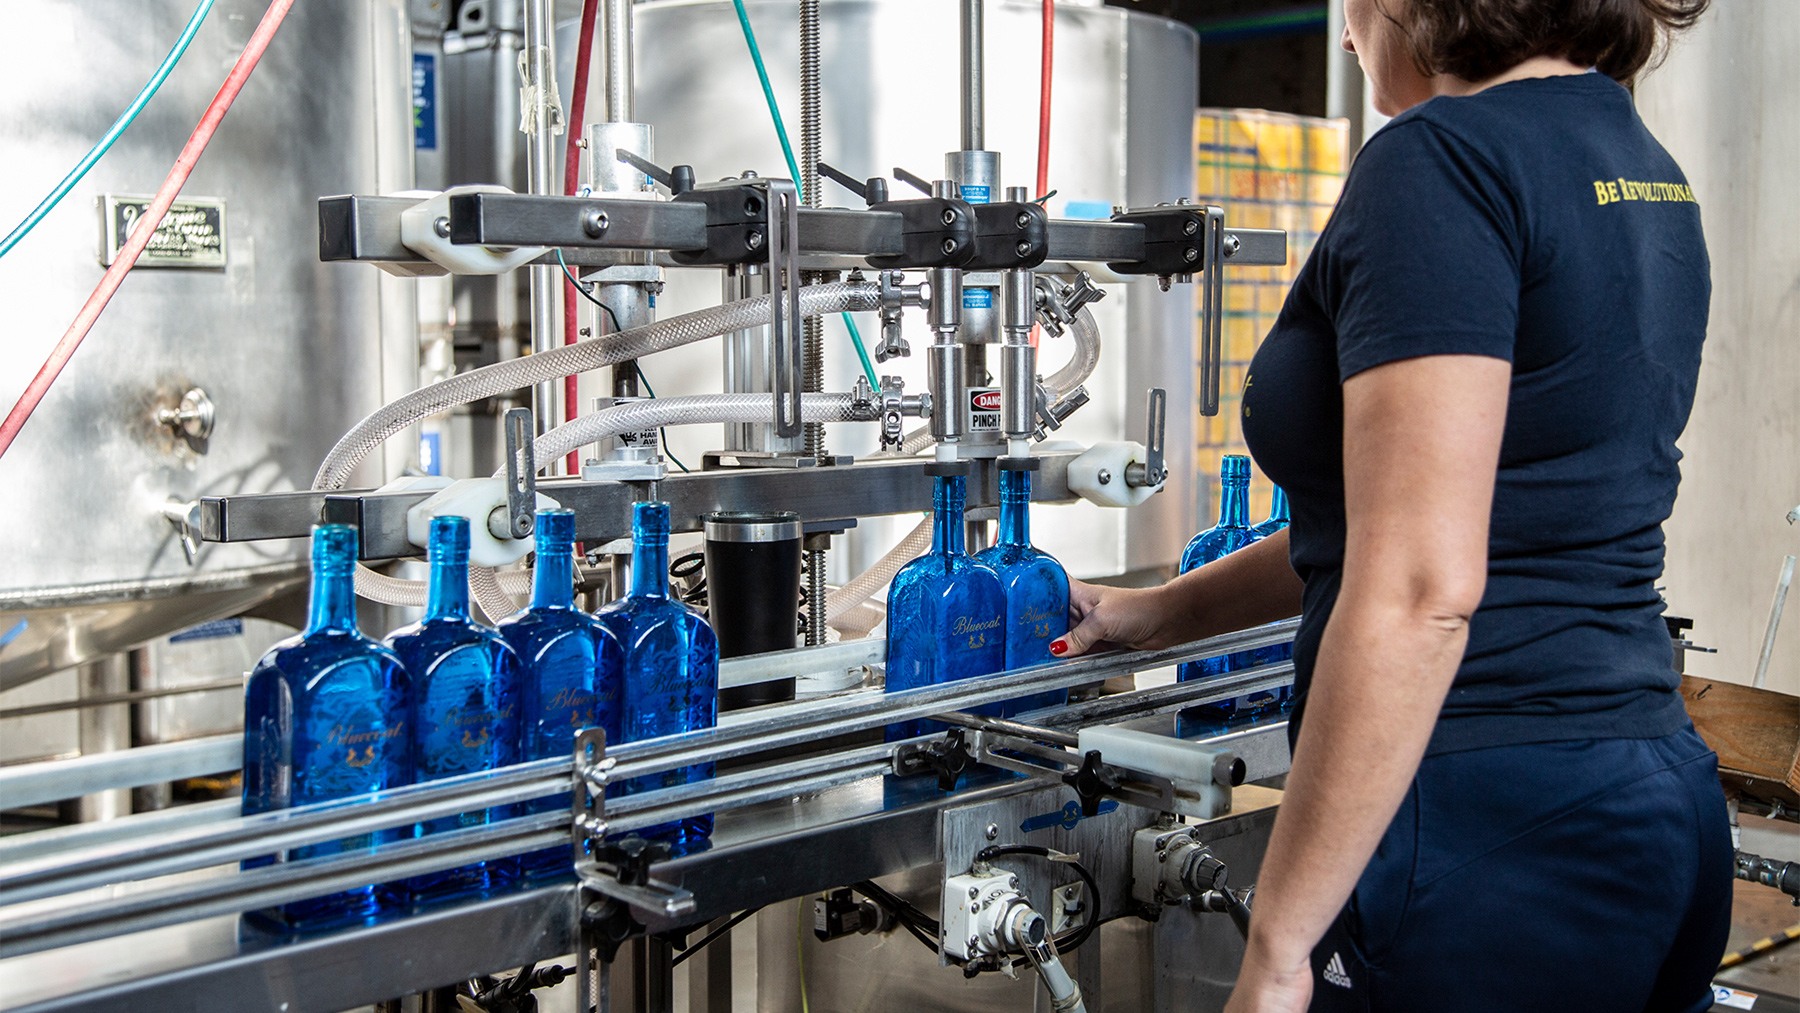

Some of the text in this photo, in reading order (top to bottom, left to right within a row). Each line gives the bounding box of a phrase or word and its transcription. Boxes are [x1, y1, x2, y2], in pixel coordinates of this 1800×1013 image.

[1593, 180, 1620, 205] BE
[972, 414, 997, 428] PINCH
[952, 614, 1000, 636] Bluecoat
[1323, 969, 1351, 988] adidas
